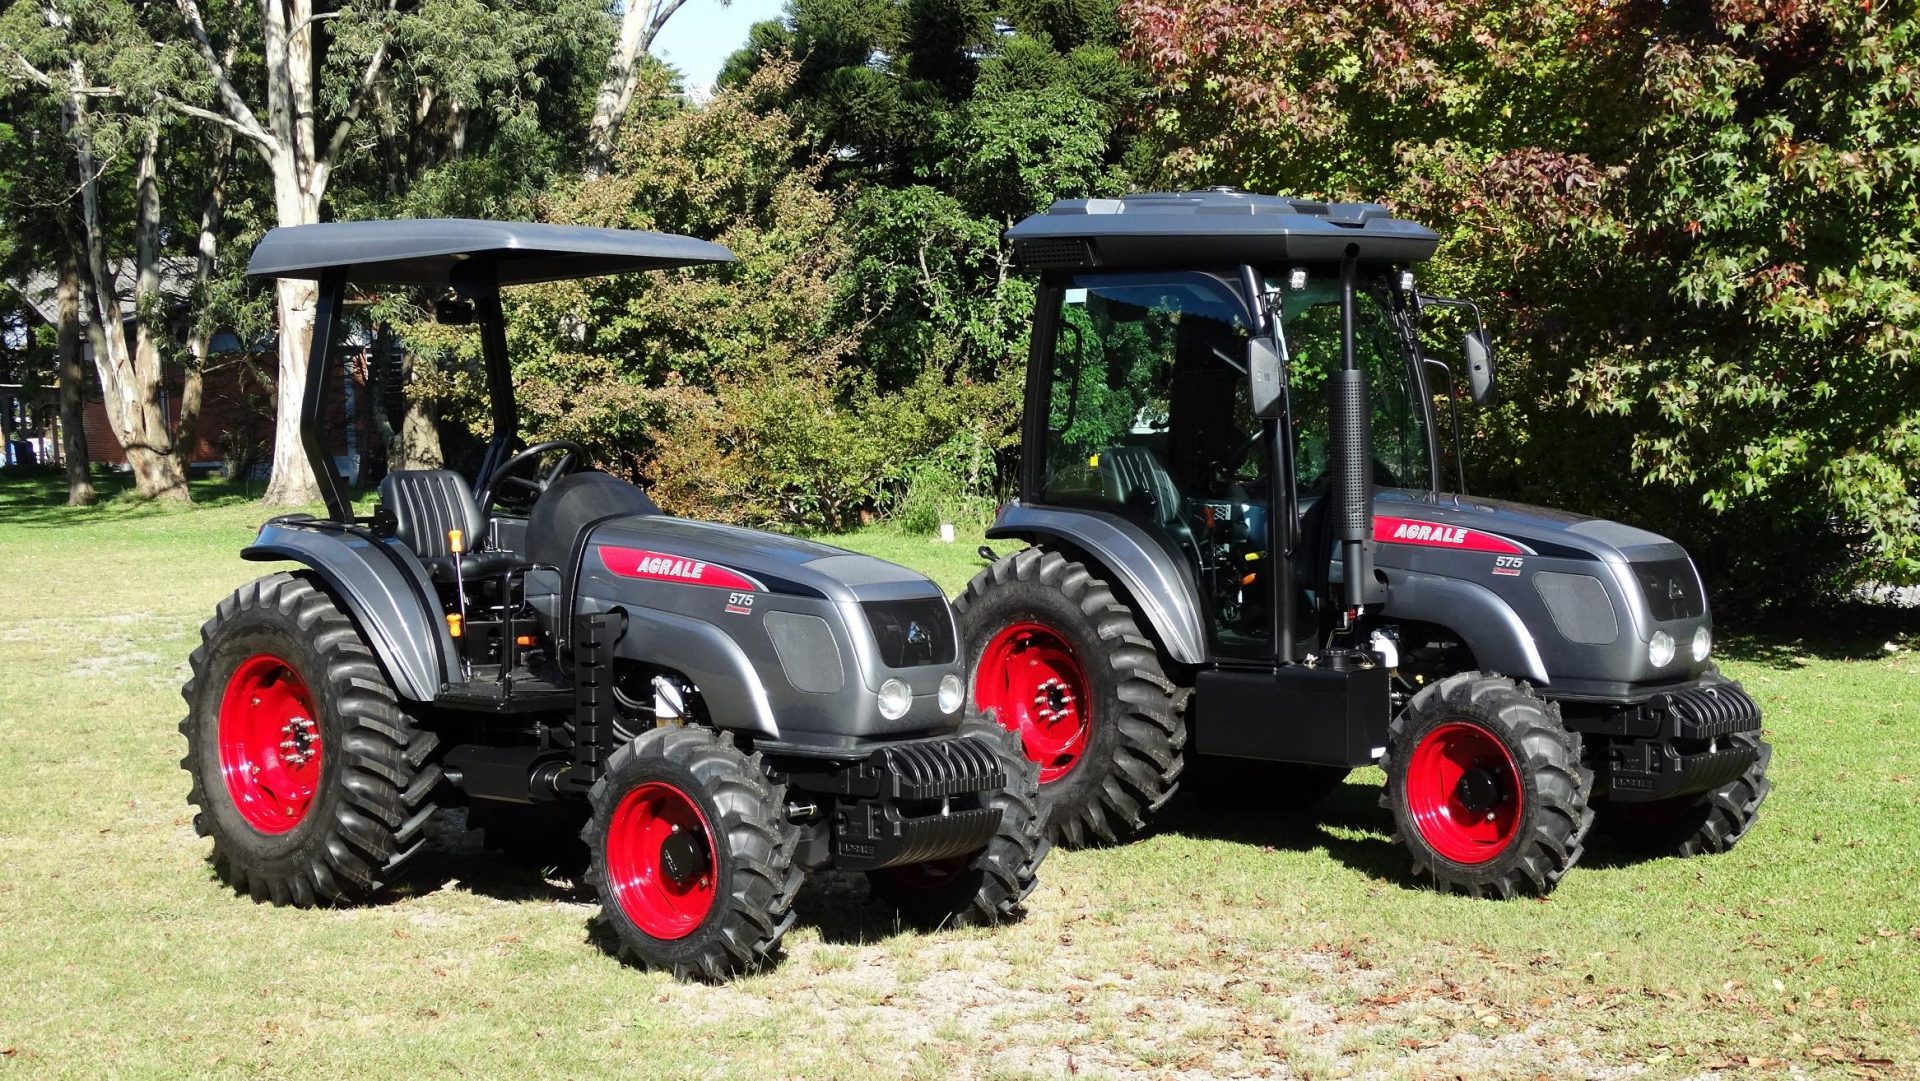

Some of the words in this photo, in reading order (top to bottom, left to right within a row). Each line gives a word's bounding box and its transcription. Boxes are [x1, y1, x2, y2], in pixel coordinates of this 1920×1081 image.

[1394, 523, 1468, 544] AGRALE
[637, 557, 705, 579] AGRALE
[1495, 556, 1523, 568] 575
[728, 592, 754, 606] 575
